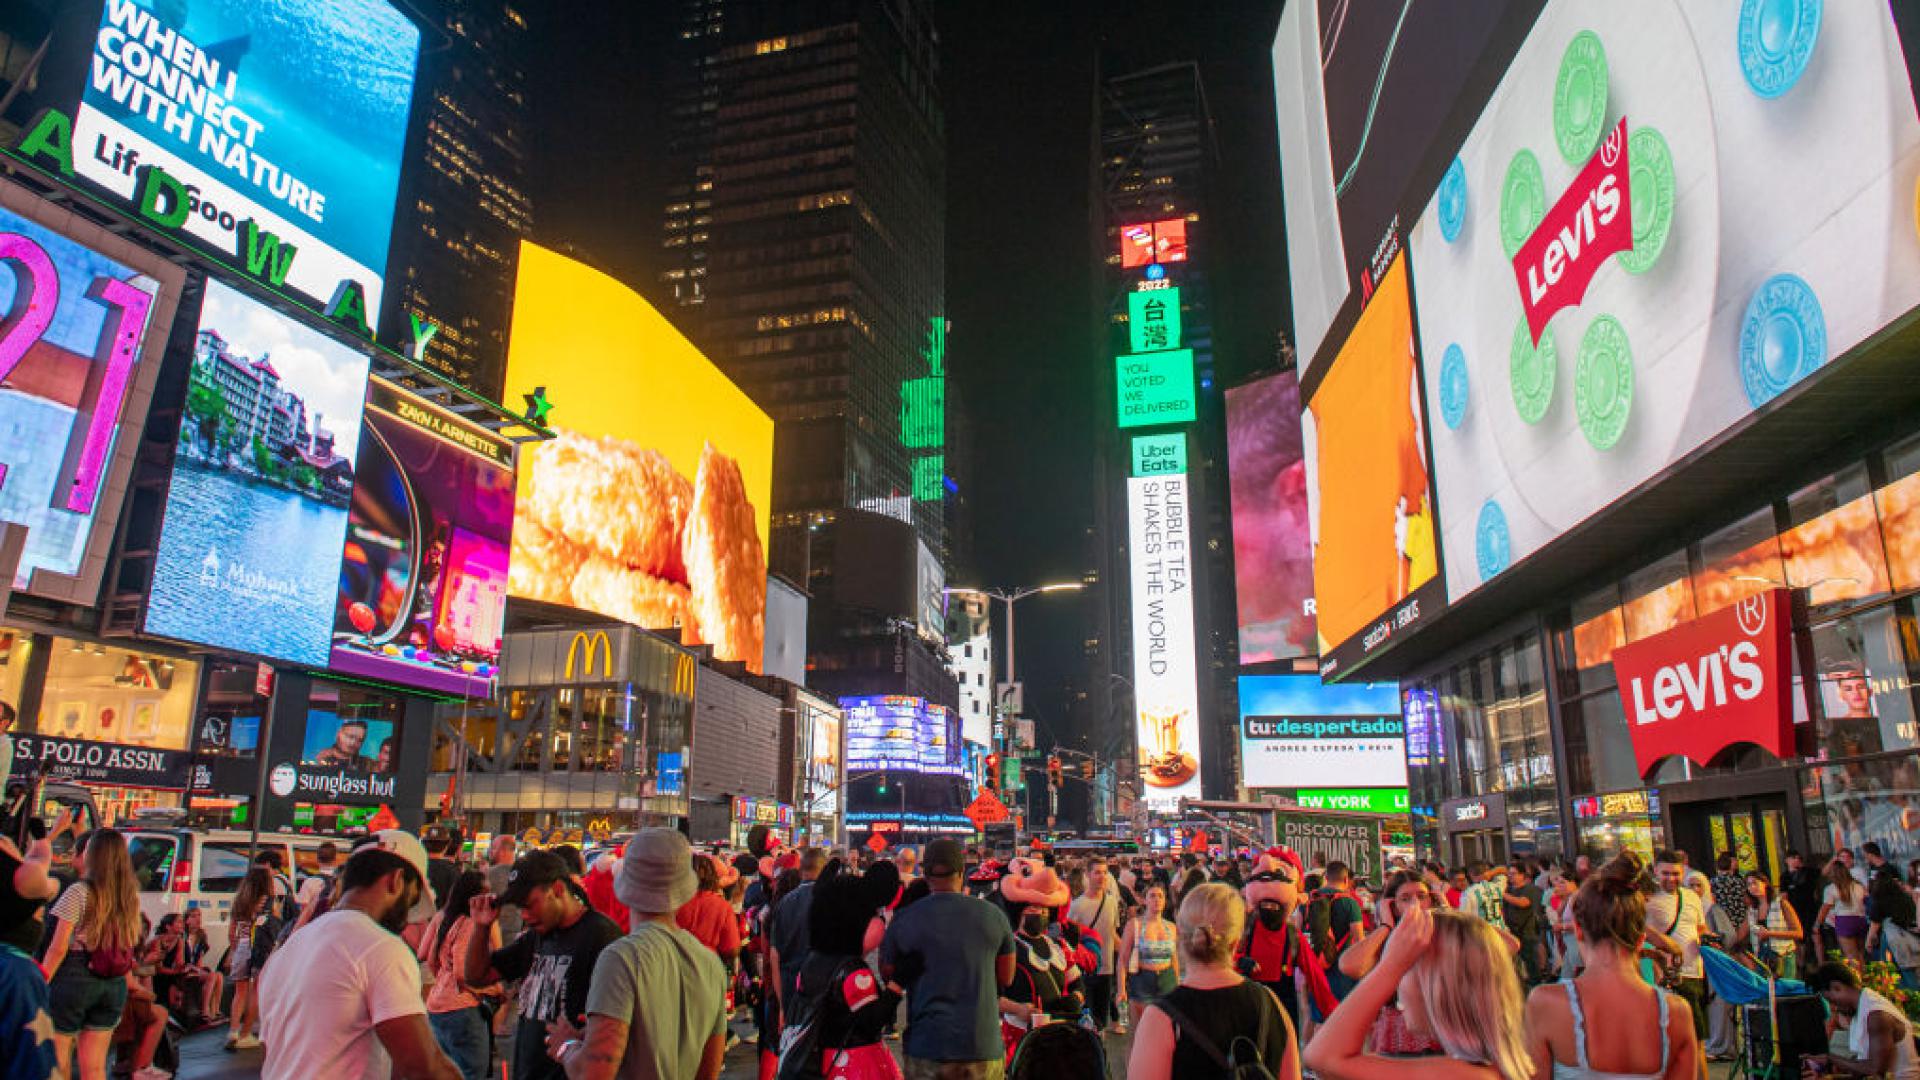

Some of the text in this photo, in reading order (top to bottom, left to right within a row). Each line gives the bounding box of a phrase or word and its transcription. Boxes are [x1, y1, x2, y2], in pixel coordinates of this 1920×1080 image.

[107, 0, 237, 99] WHEN I
[98, 28, 263, 147] CONNECT
[92, 55, 326, 223] WITH NATURE
[1137, 278, 1170, 292] 2022
[1123, 363, 1149, 374] YOU
[1124, 375, 1166, 388] VOTED
[1124, 390, 1143, 401] WE
[1124, 401, 1190, 416] DELIVERED
[440, 424, 498, 458] ARNETTE
[1141, 444, 1176, 458] Uber
[1141, 457, 1179, 473] Eats
[1164, 480, 1186, 593] BUBBLE TEA
[1143, 481, 1168, 676] SHAKES THE WORLD
[40, 741, 103, 764] POLO
[106, 748, 167, 772] ASSN.
[300, 770, 395, 799] sunglass hut
[1327, 795, 1372, 808] YORK
[1285, 822, 1369, 839] DISCOVER
